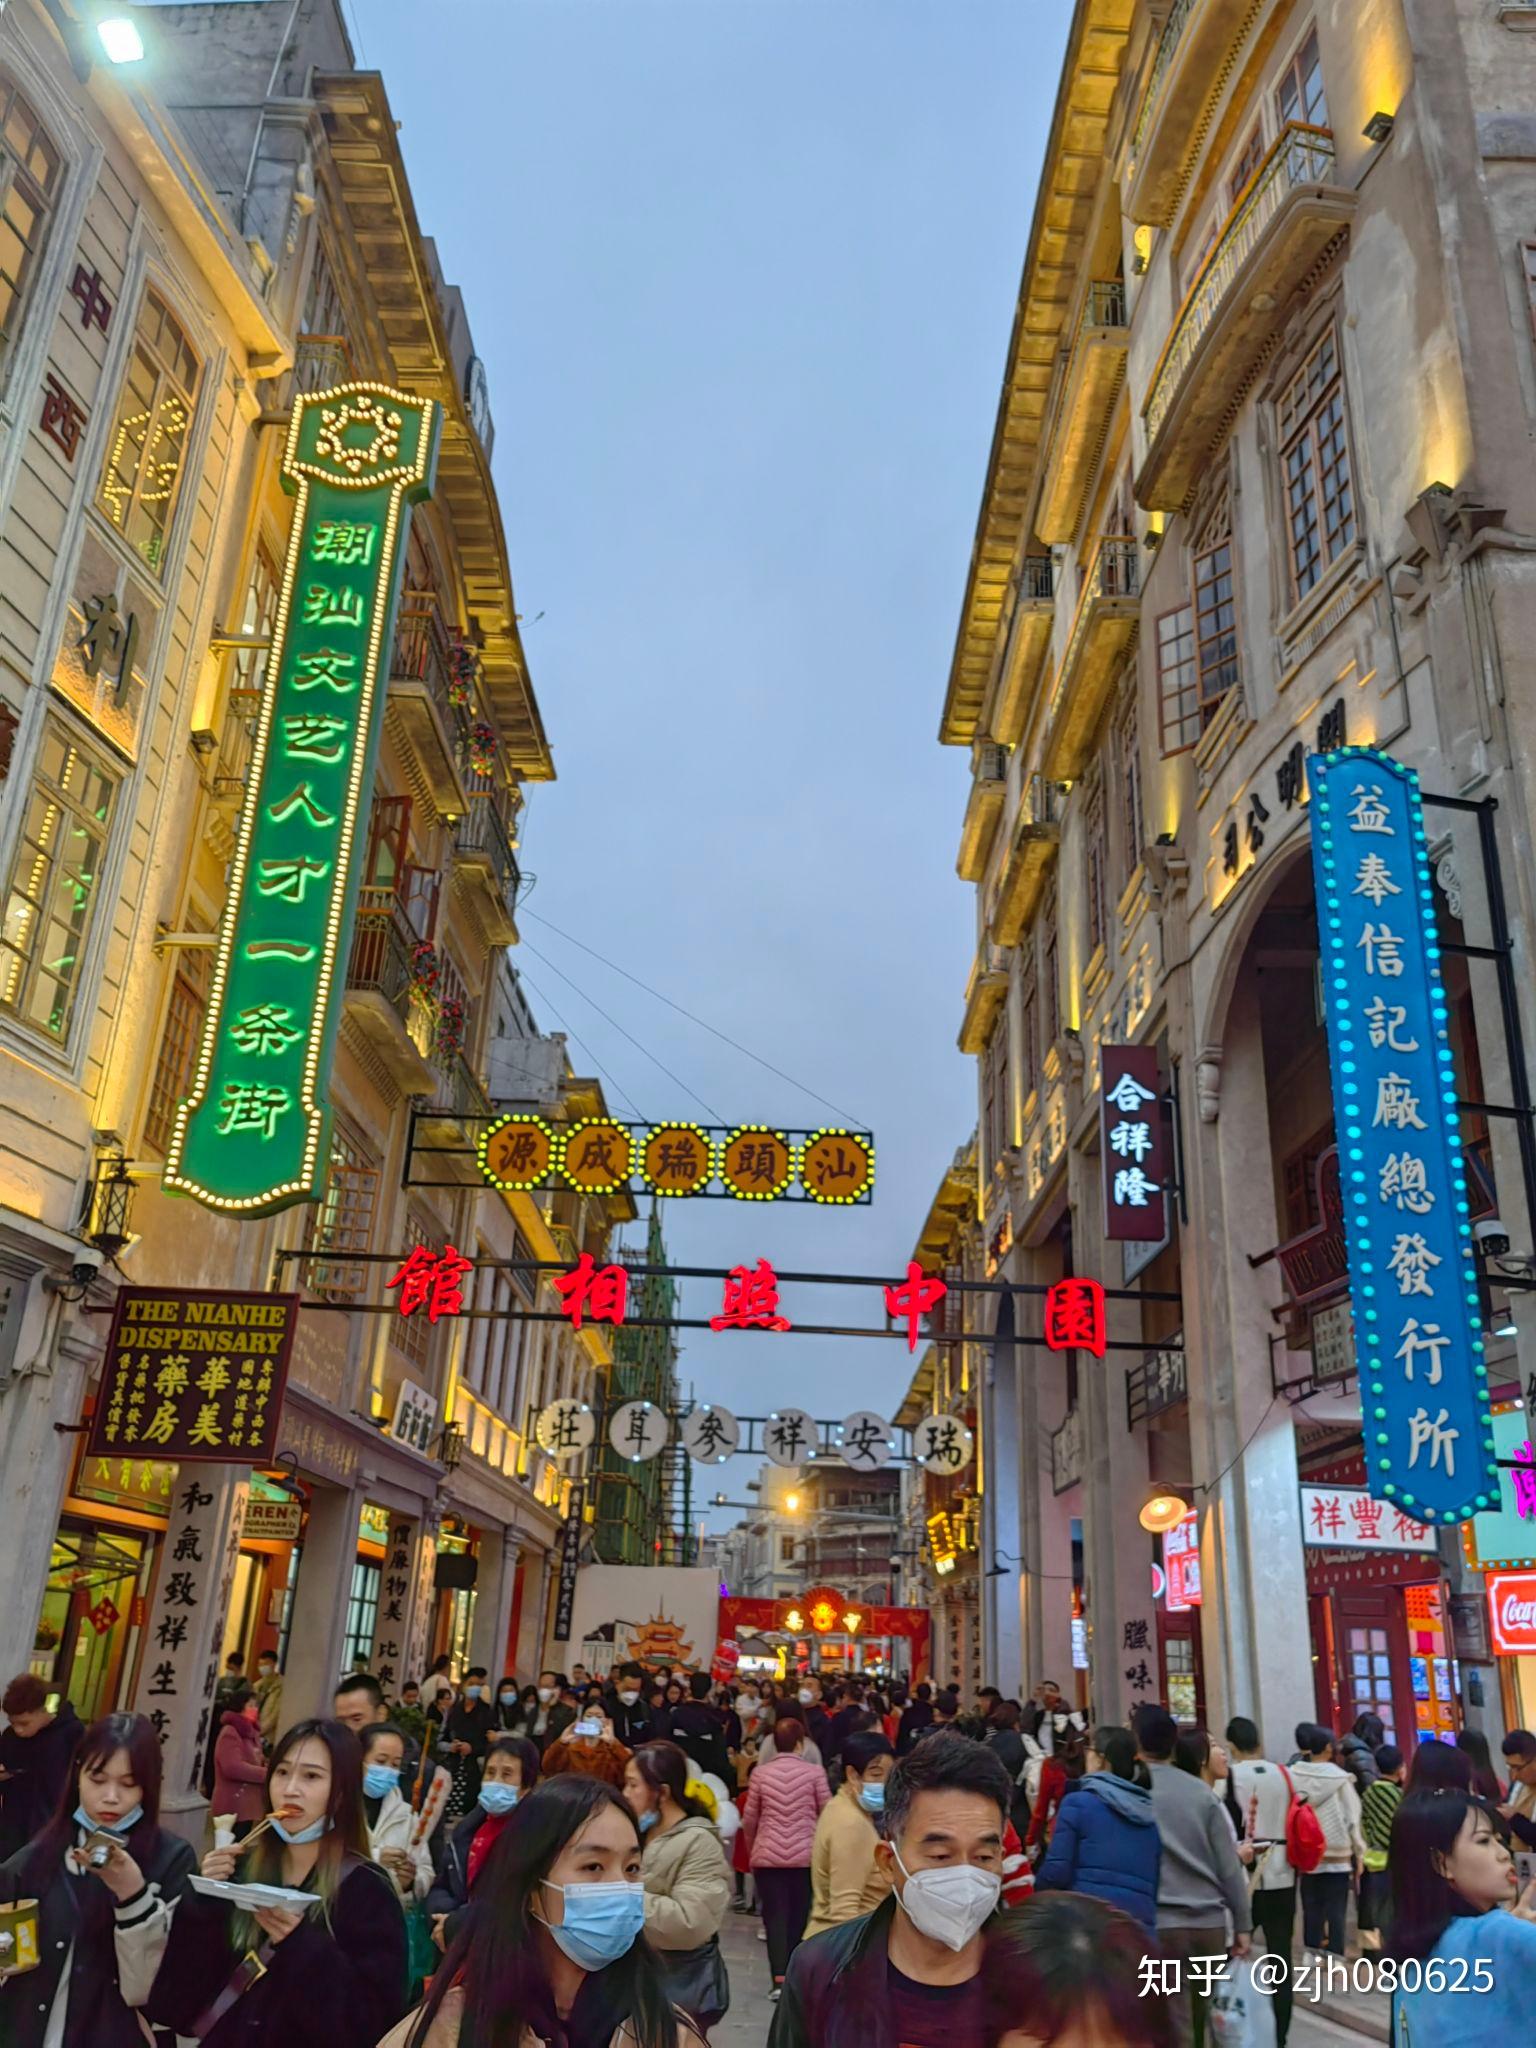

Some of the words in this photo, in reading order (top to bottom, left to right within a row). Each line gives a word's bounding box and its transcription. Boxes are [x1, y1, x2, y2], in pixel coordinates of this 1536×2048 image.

[40, 262, 113, 463] 中西
[216, 520, 376, 1141] 潮汕文艺人才一条街
[1106, 1073, 1160, 1206] 合祥隆
[117, 1327, 284, 1354] DISPENSARY
[126, 1300, 179, 1322] THE
[185, 1302, 286, 1327] NIANHE
[1122, 1618, 1153, 1720] 臘味
